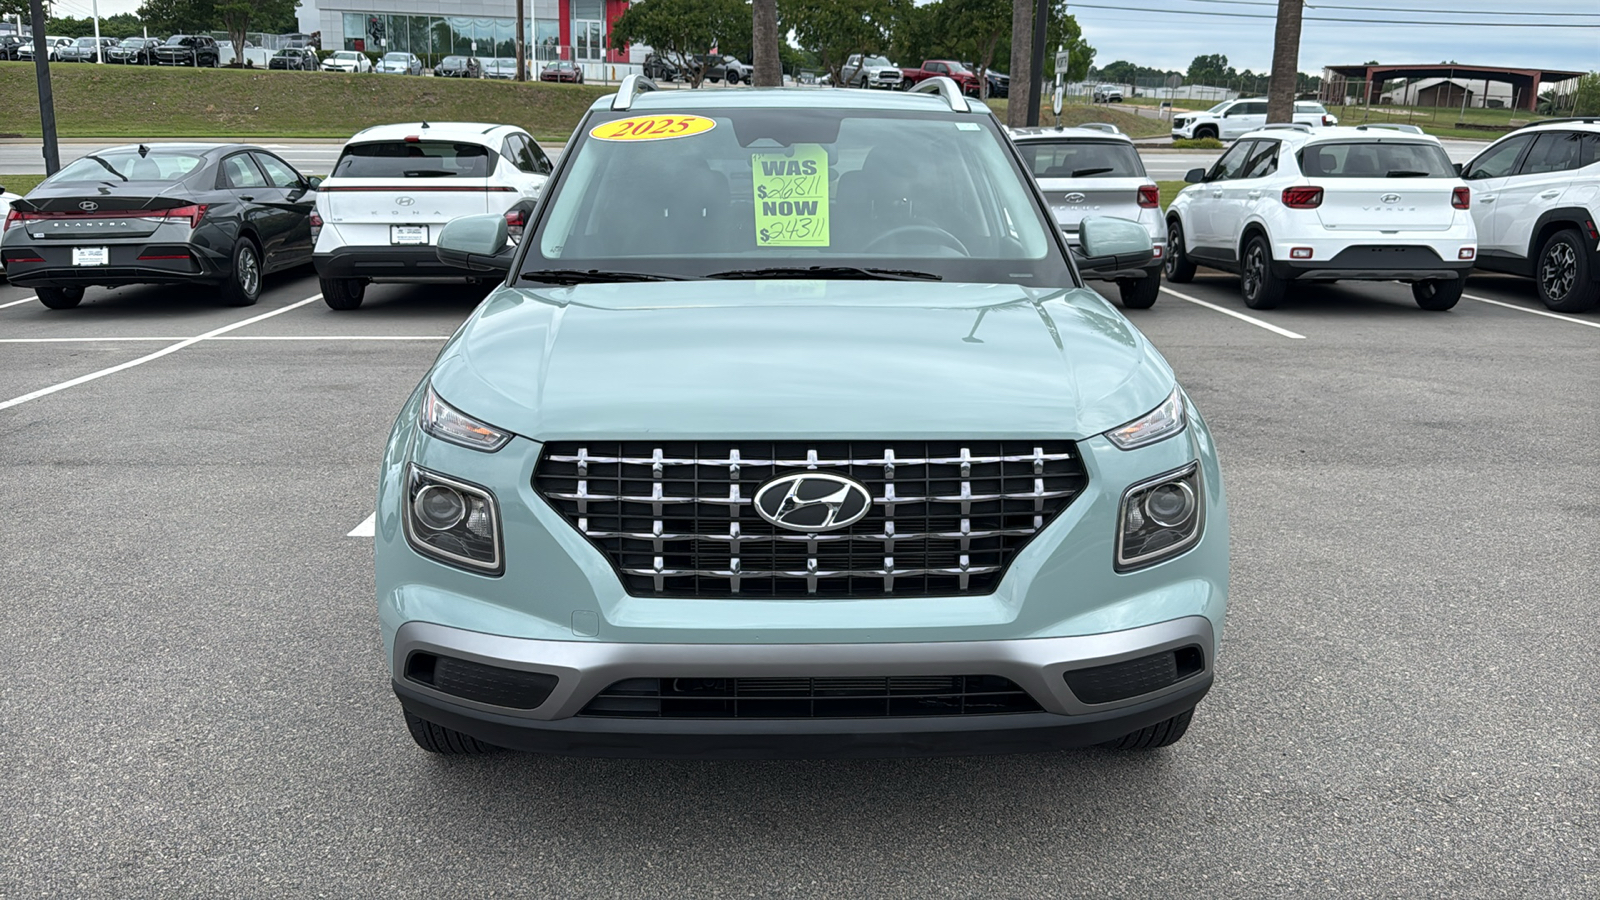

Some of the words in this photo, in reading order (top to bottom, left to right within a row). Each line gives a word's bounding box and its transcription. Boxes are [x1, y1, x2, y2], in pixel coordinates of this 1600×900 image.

[608, 118, 696, 138] 2025
[761, 160, 818, 176] WAS
[762, 201, 818, 216] NOW
